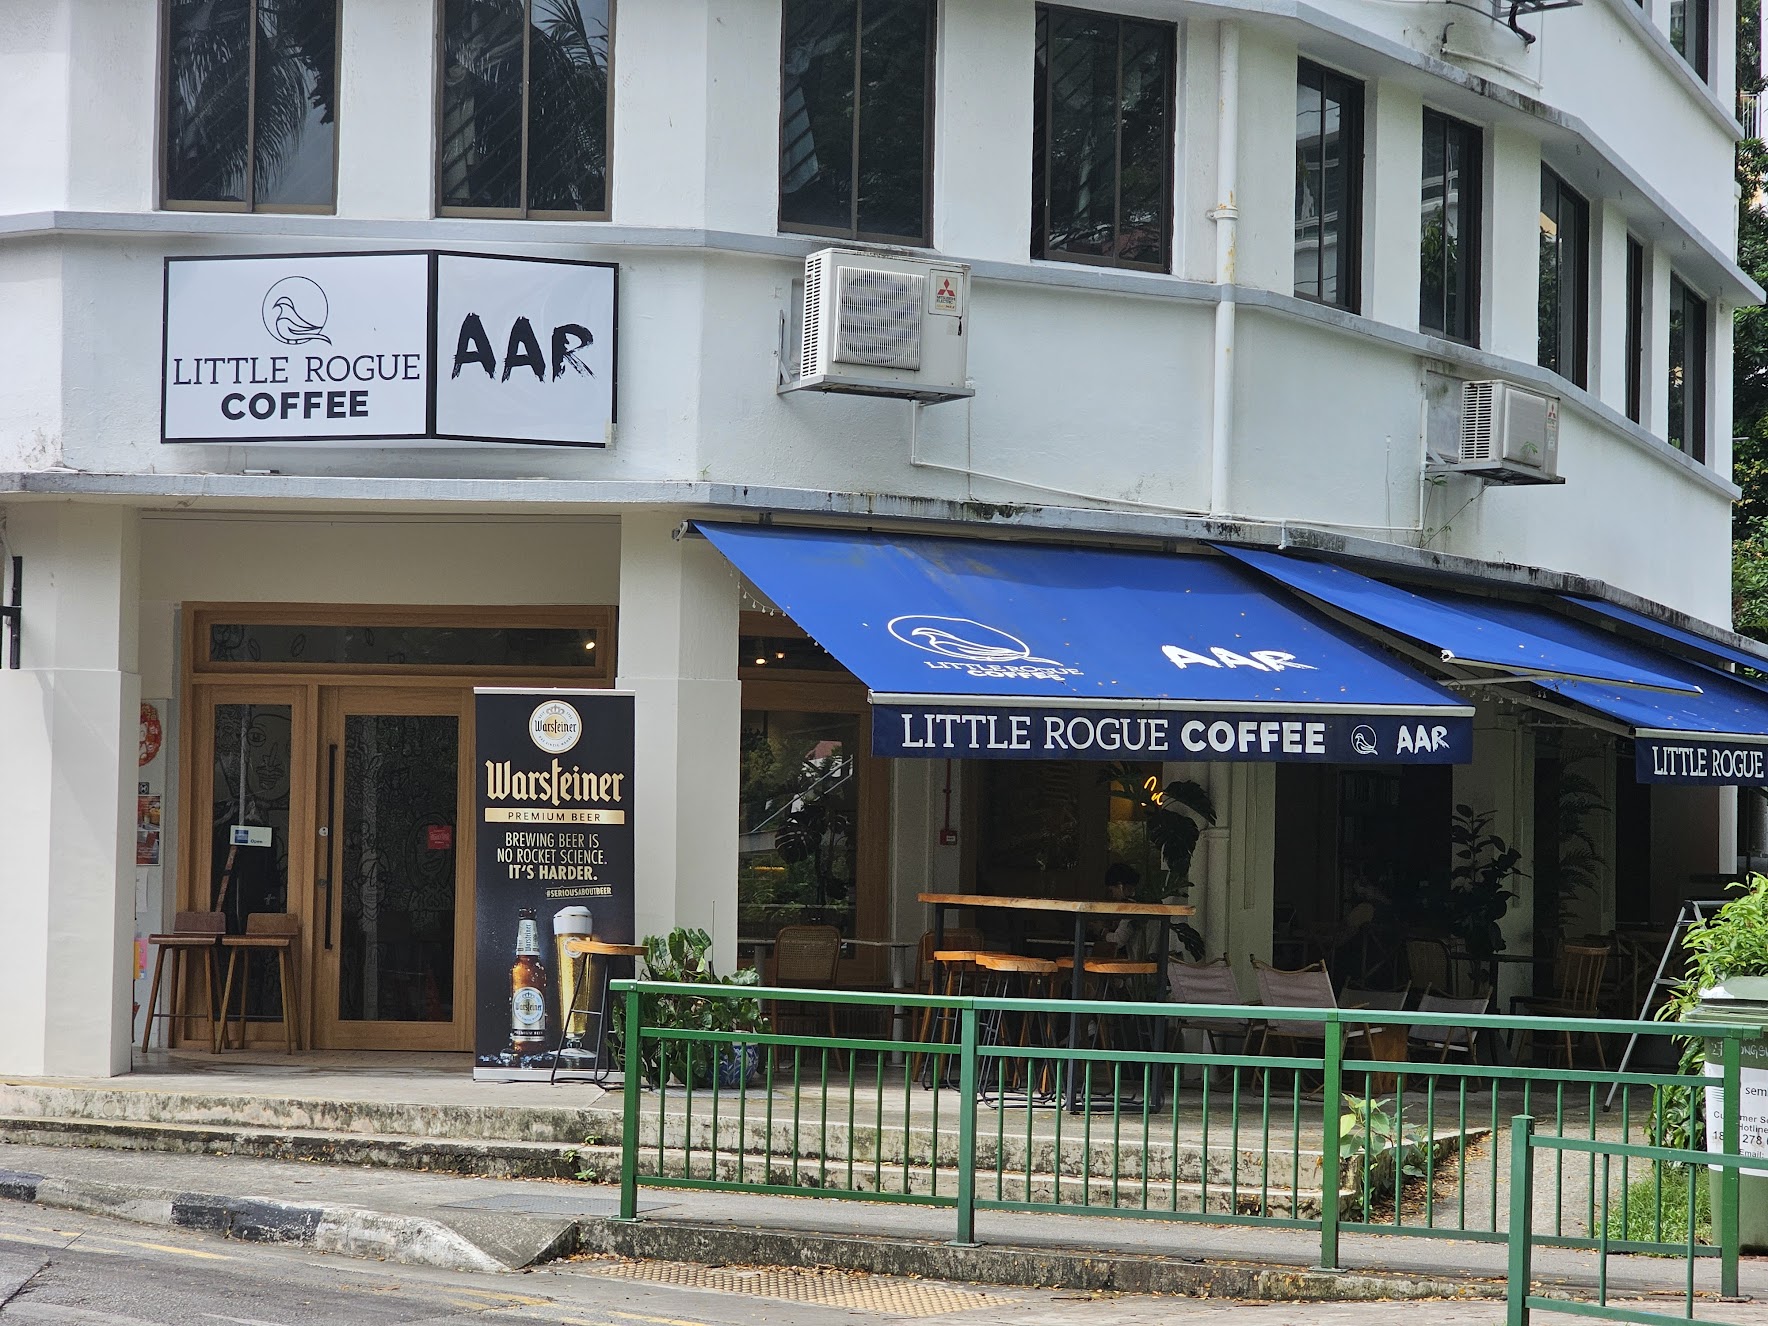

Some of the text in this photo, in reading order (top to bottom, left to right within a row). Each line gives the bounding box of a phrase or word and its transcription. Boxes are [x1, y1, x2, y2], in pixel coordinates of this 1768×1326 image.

[451, 312, 597, 383] AAR
[173, 354, 421, 386] LITTLE ROGUE
[221, 390, 369, 421] COFFEE
[1161, 644, 1319, 672] AAR
[924, 661, 1084, 676] LITTLE ROGUE
[967, 670, 1066, 681] COFFEE
[535, 719, 577, 733] Warsteiner
[901, 713, 1326, 754] LITTLE ROGUE COFFEE
[1396, 725, 1450, 755] AAR
[1652, 746, 1765, 778] LITTLE ROGUE
[485, 758, 625, 806] Warsteiner
[508, 812, 601, 822] PREMIUM BEER
[505, 832, 599, 848] BREWING BEER IS
[497, 848, 608, 865] NO ROCKET SCIENCE.
[509, 864, 598, 881] IT'S HARDER.
[546, 886, 612, 898] #SERIOUSABOUTBEER
[1745, 1087, 1768, 1097] sem
[1742, 1134, 1763, 1145] 278
